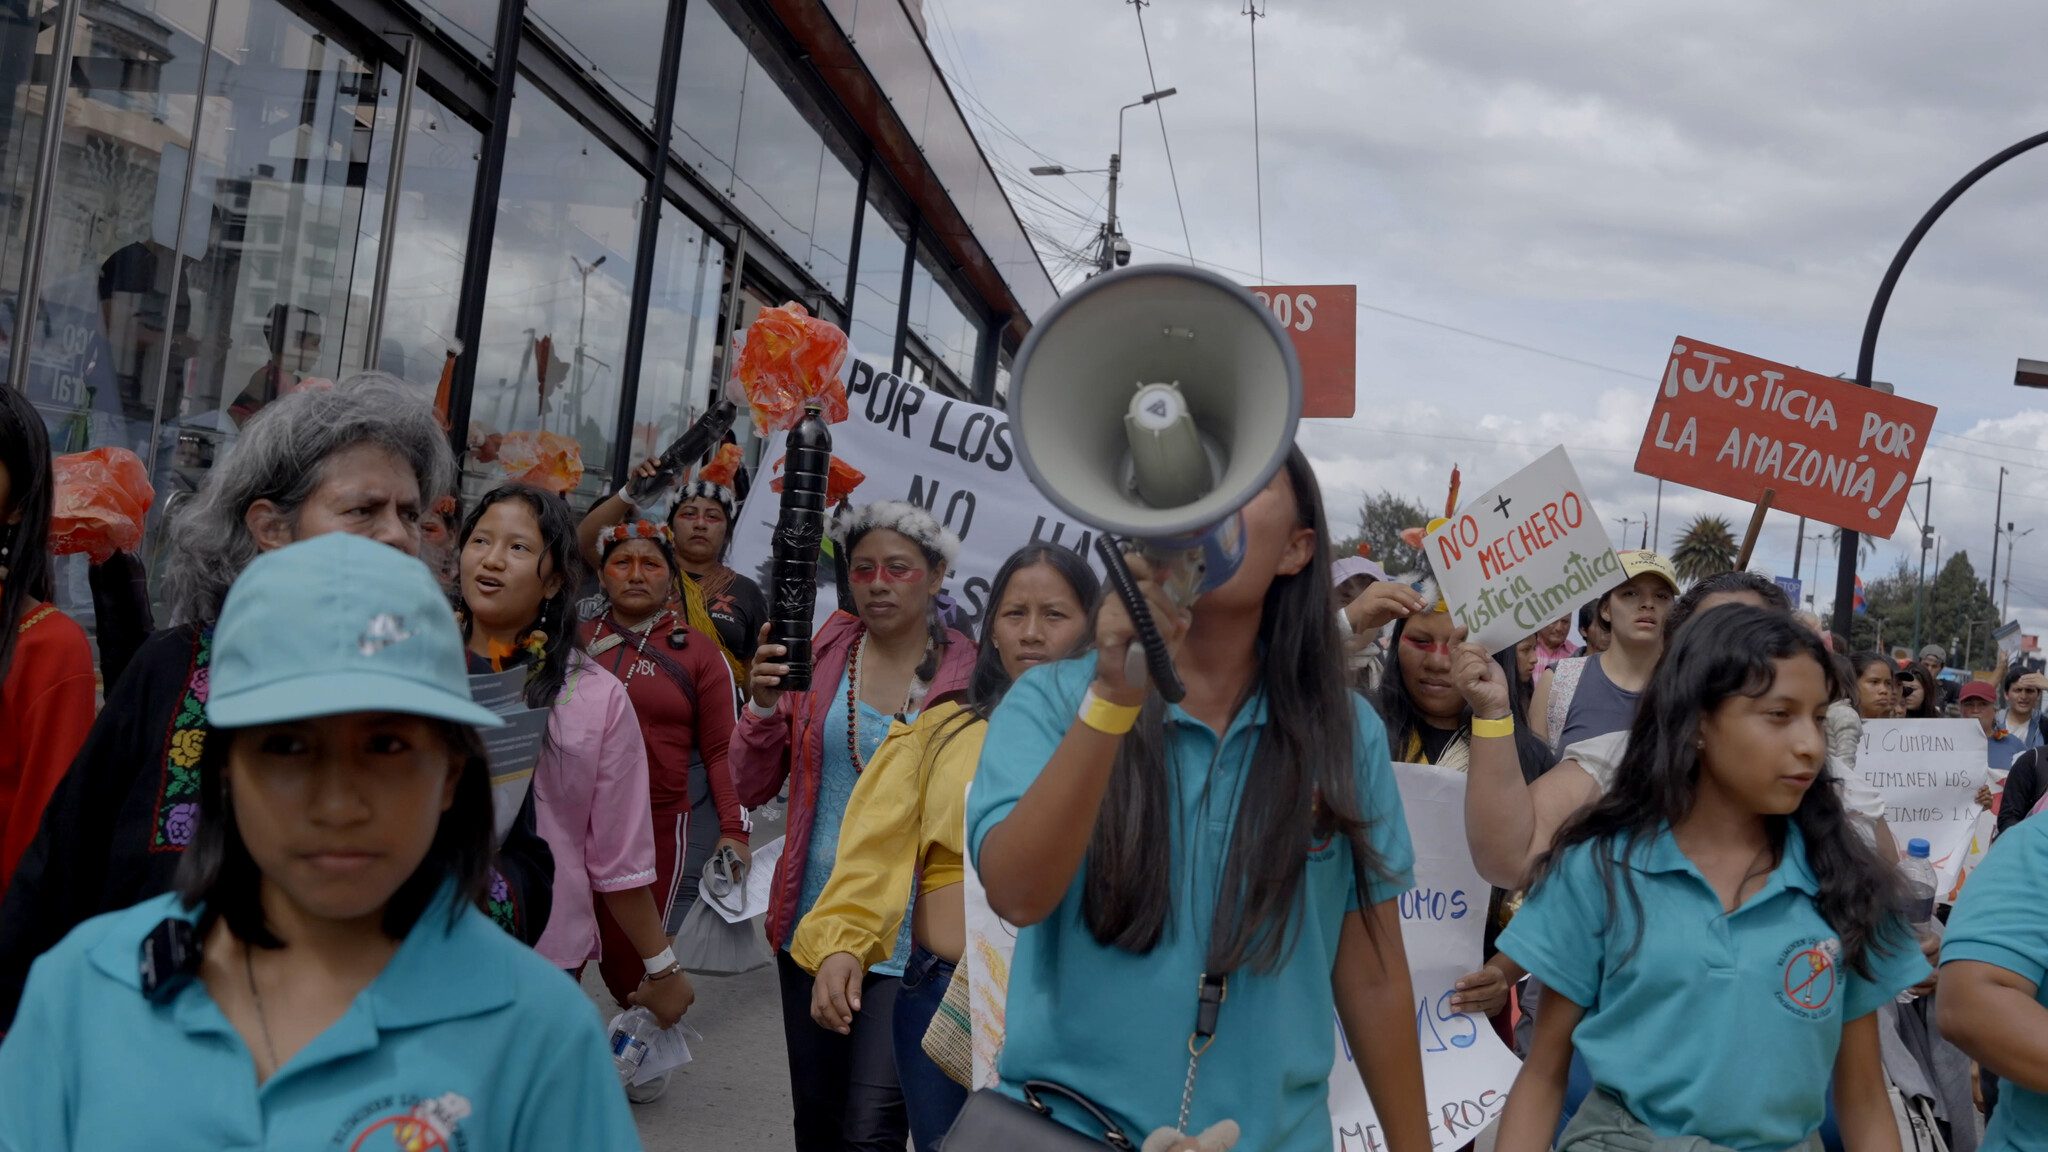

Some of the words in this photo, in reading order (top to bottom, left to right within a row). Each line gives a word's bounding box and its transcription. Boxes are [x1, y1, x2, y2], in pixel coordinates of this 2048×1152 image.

[848, 358, 925, 438] POR
[929, 401, 1013, 472] LOS
[1655, 411, 1697, 457] LA
[1859, 411, 1916, 459] POR
[906, 474, 976, 543] NO
[1477, 490, 1583, 581] MECHERO
[1437, 514, 1479, 571] NO
[1513, 546, 1620, 631] Climática
[711, 611, 736, 624] ROCK
[1945, 770, 1972, 788] LOS
